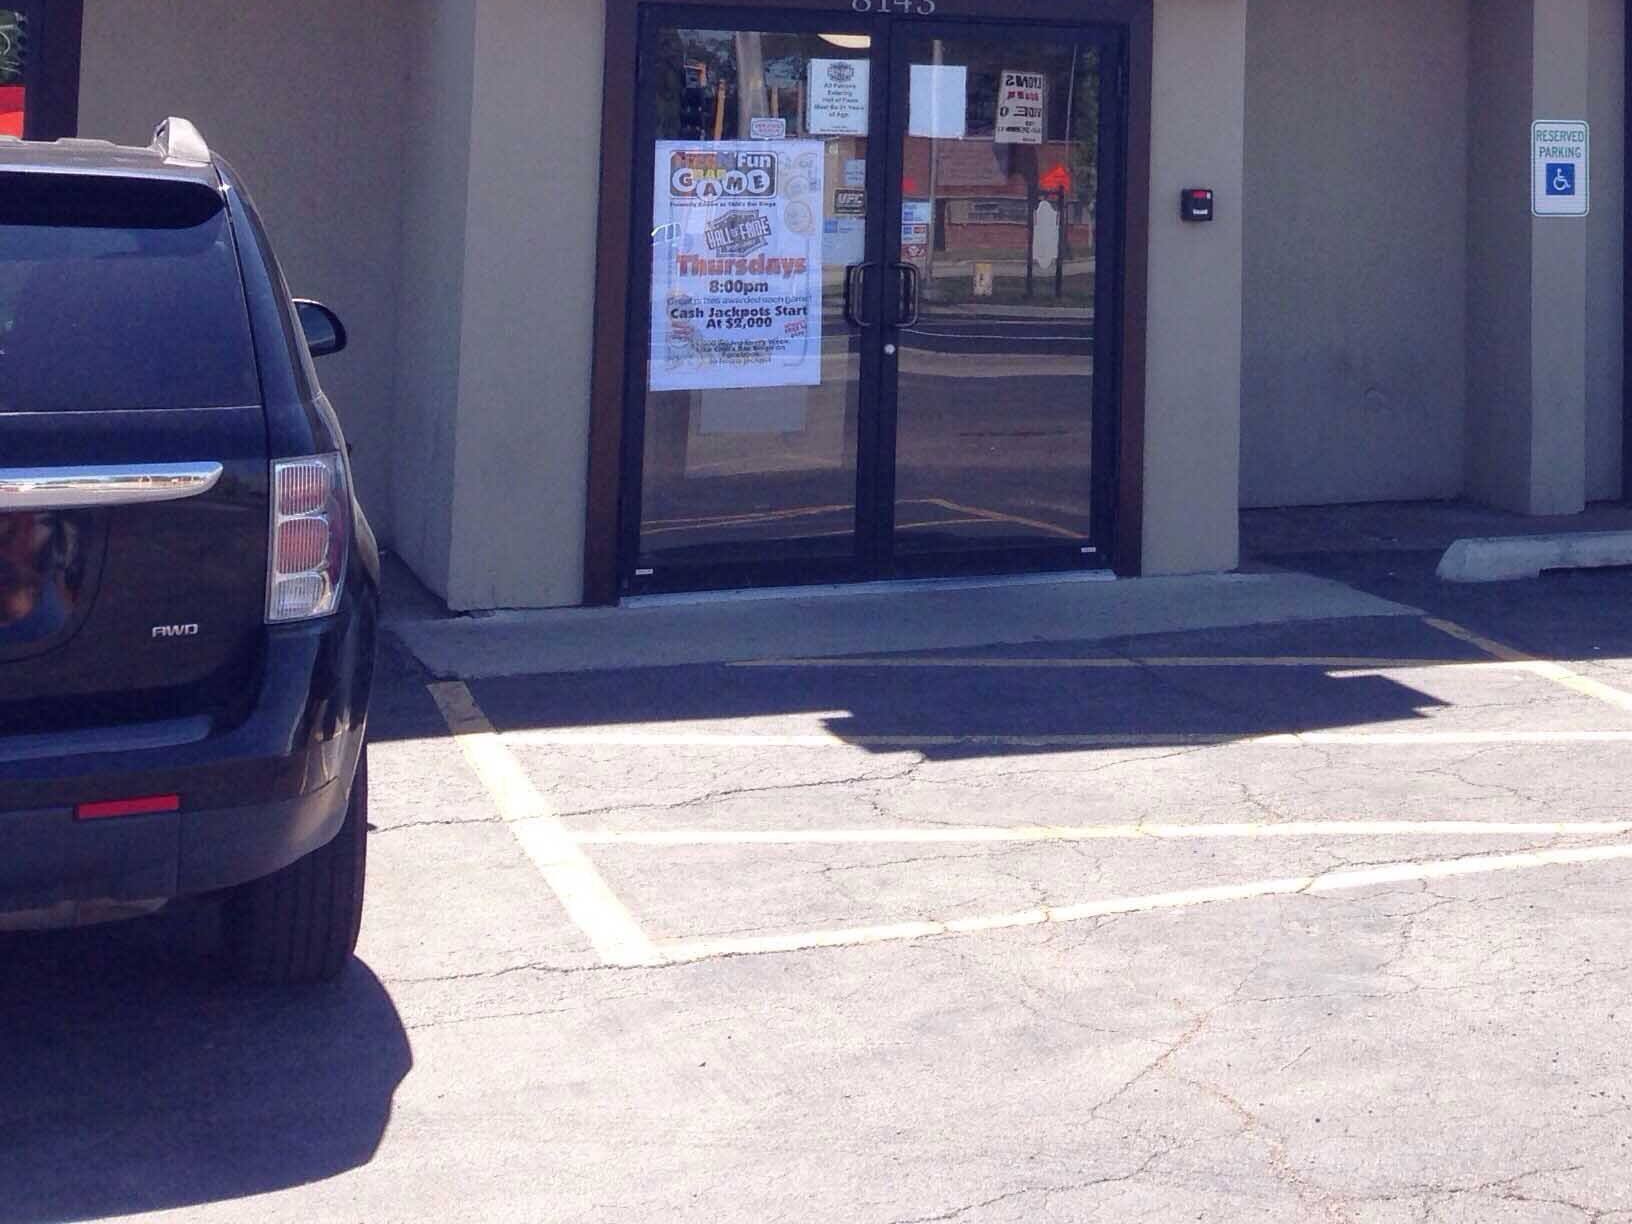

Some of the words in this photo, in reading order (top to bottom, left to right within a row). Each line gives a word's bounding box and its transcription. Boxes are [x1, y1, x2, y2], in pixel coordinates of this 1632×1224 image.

[1535, 129, 1585, 143] RESERVED
[1539, 146, 1582, 158] PARKING
[736, 152, 771, 168] Fun
[837, 192, 864, 204] UFC
[676, 253, 806, 279] Thursdays
[709, 279, 769, 295] 8:00pm
[671, 307, 704, 319] Cash
[708, 306, 771, 319] Jackpots
[775, 305, 808, 316] Start
[706, 318, 722, 329] At
[725, 317, 773, 329] $2,000
[152, 623, 199, 638] AWD
